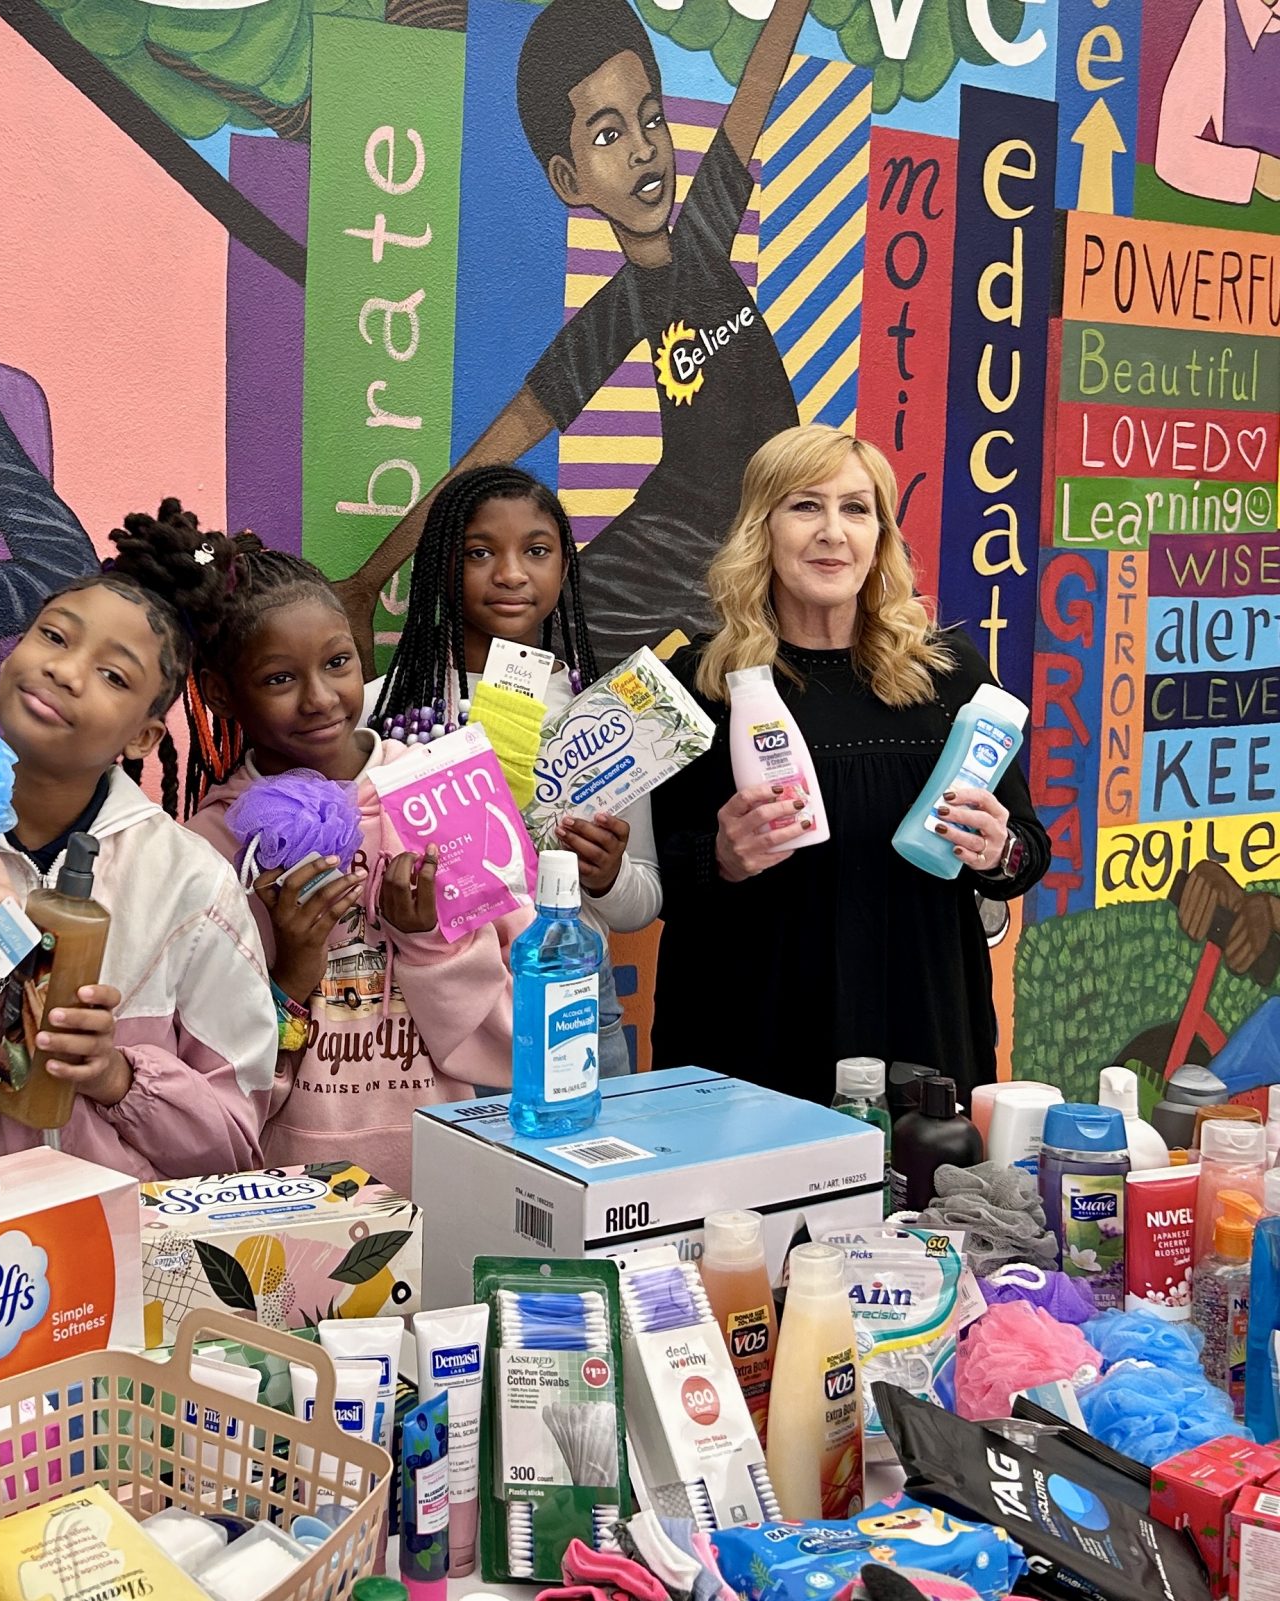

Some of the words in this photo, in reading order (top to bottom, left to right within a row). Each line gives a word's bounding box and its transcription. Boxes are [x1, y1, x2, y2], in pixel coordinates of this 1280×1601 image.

[673, 307, 754, 380] Believe
[1078, 327, 1258, 402] Beautiful
[1081, 413, 1232, 473] LOVED
[1061, 479, 1243, 546] Learning
[1165, 546, 1280, 587] WISE
[505, 663, 533, 679] Bliss
[1105, 554, 1138, 818] STRONG
[756, 733, 786, 751] VO5
[1030, 554, 1097, 917] GREAT
[532, 714, 626, 803] Scotties
[574, 778, 605, 801] everyday
[603, 758, 633, 780] comfort
[628, 767, 643, 779] 150
[402, 768, 497, 837] grin
[1100, 820, 1280, 892] agile
[450, 915, 464, 928] 60
[573, 985, 591, 996] swan
[555, 1011, 596, 1033] Mouthwash
[365, 1080, 381, 1092] ON
[454, 1103, 509, 1118] RICO
[841, 1172, 867, 1186] 1692255
[158, 1180, 316, 1215] Scotties
[1071, 1196, 1116, 1212] Suave
[605, 1201, 650, 1234] RICO
[1146, 1207, 1195, 1228] NUVEL
[926, 1236, 949, 1249] 60
[1153, 1229, 1190, 1242] JAPANESE
[1157, 1239, 1187, 1249] CHERRY
[850, 1250, 873, 1259] Picks
[926, 1248, 947, 1258] Pack
[1154, 1247, 1191, 1258] BLOSSOM
[848, 1281, 912, 1306] Aim
[1102, 1293, 1116, 1301] TEA
[52, 1303, 94, 1326] Simple
[734, 1312, 754, 1322] BONUS
[754, 1308, 765, 1318] SIZE
[52, 1317, 106, 1342] Softness
[665, 1342, 691, 1359] deal
[733, 1328, 767, 1355] VO5
[434, 1349, 480, 1369] Dermasil
[507, 1355, 555, 1369] ASSURED
[450, 1367, 466, 1375] LABS
[539, 1369, 558, 1377] Cotton
[507, 1375, 537, 1386] Cotton
[539, 1376, 570, 1387] Swabs
[827, 1368, 854, 1398] VO5
[684, 1388, 714, 1408] 300
[825, 1407, 843, 1423] Extra
[843, 1400, 857, 1416] Body
[509, 1466, 536, 1481] 300
[508, 1488, 527, 1496] Plastic
[527, 1488, 545, 1497] sticks
[986, 1447, 1033, 1522] TAG
